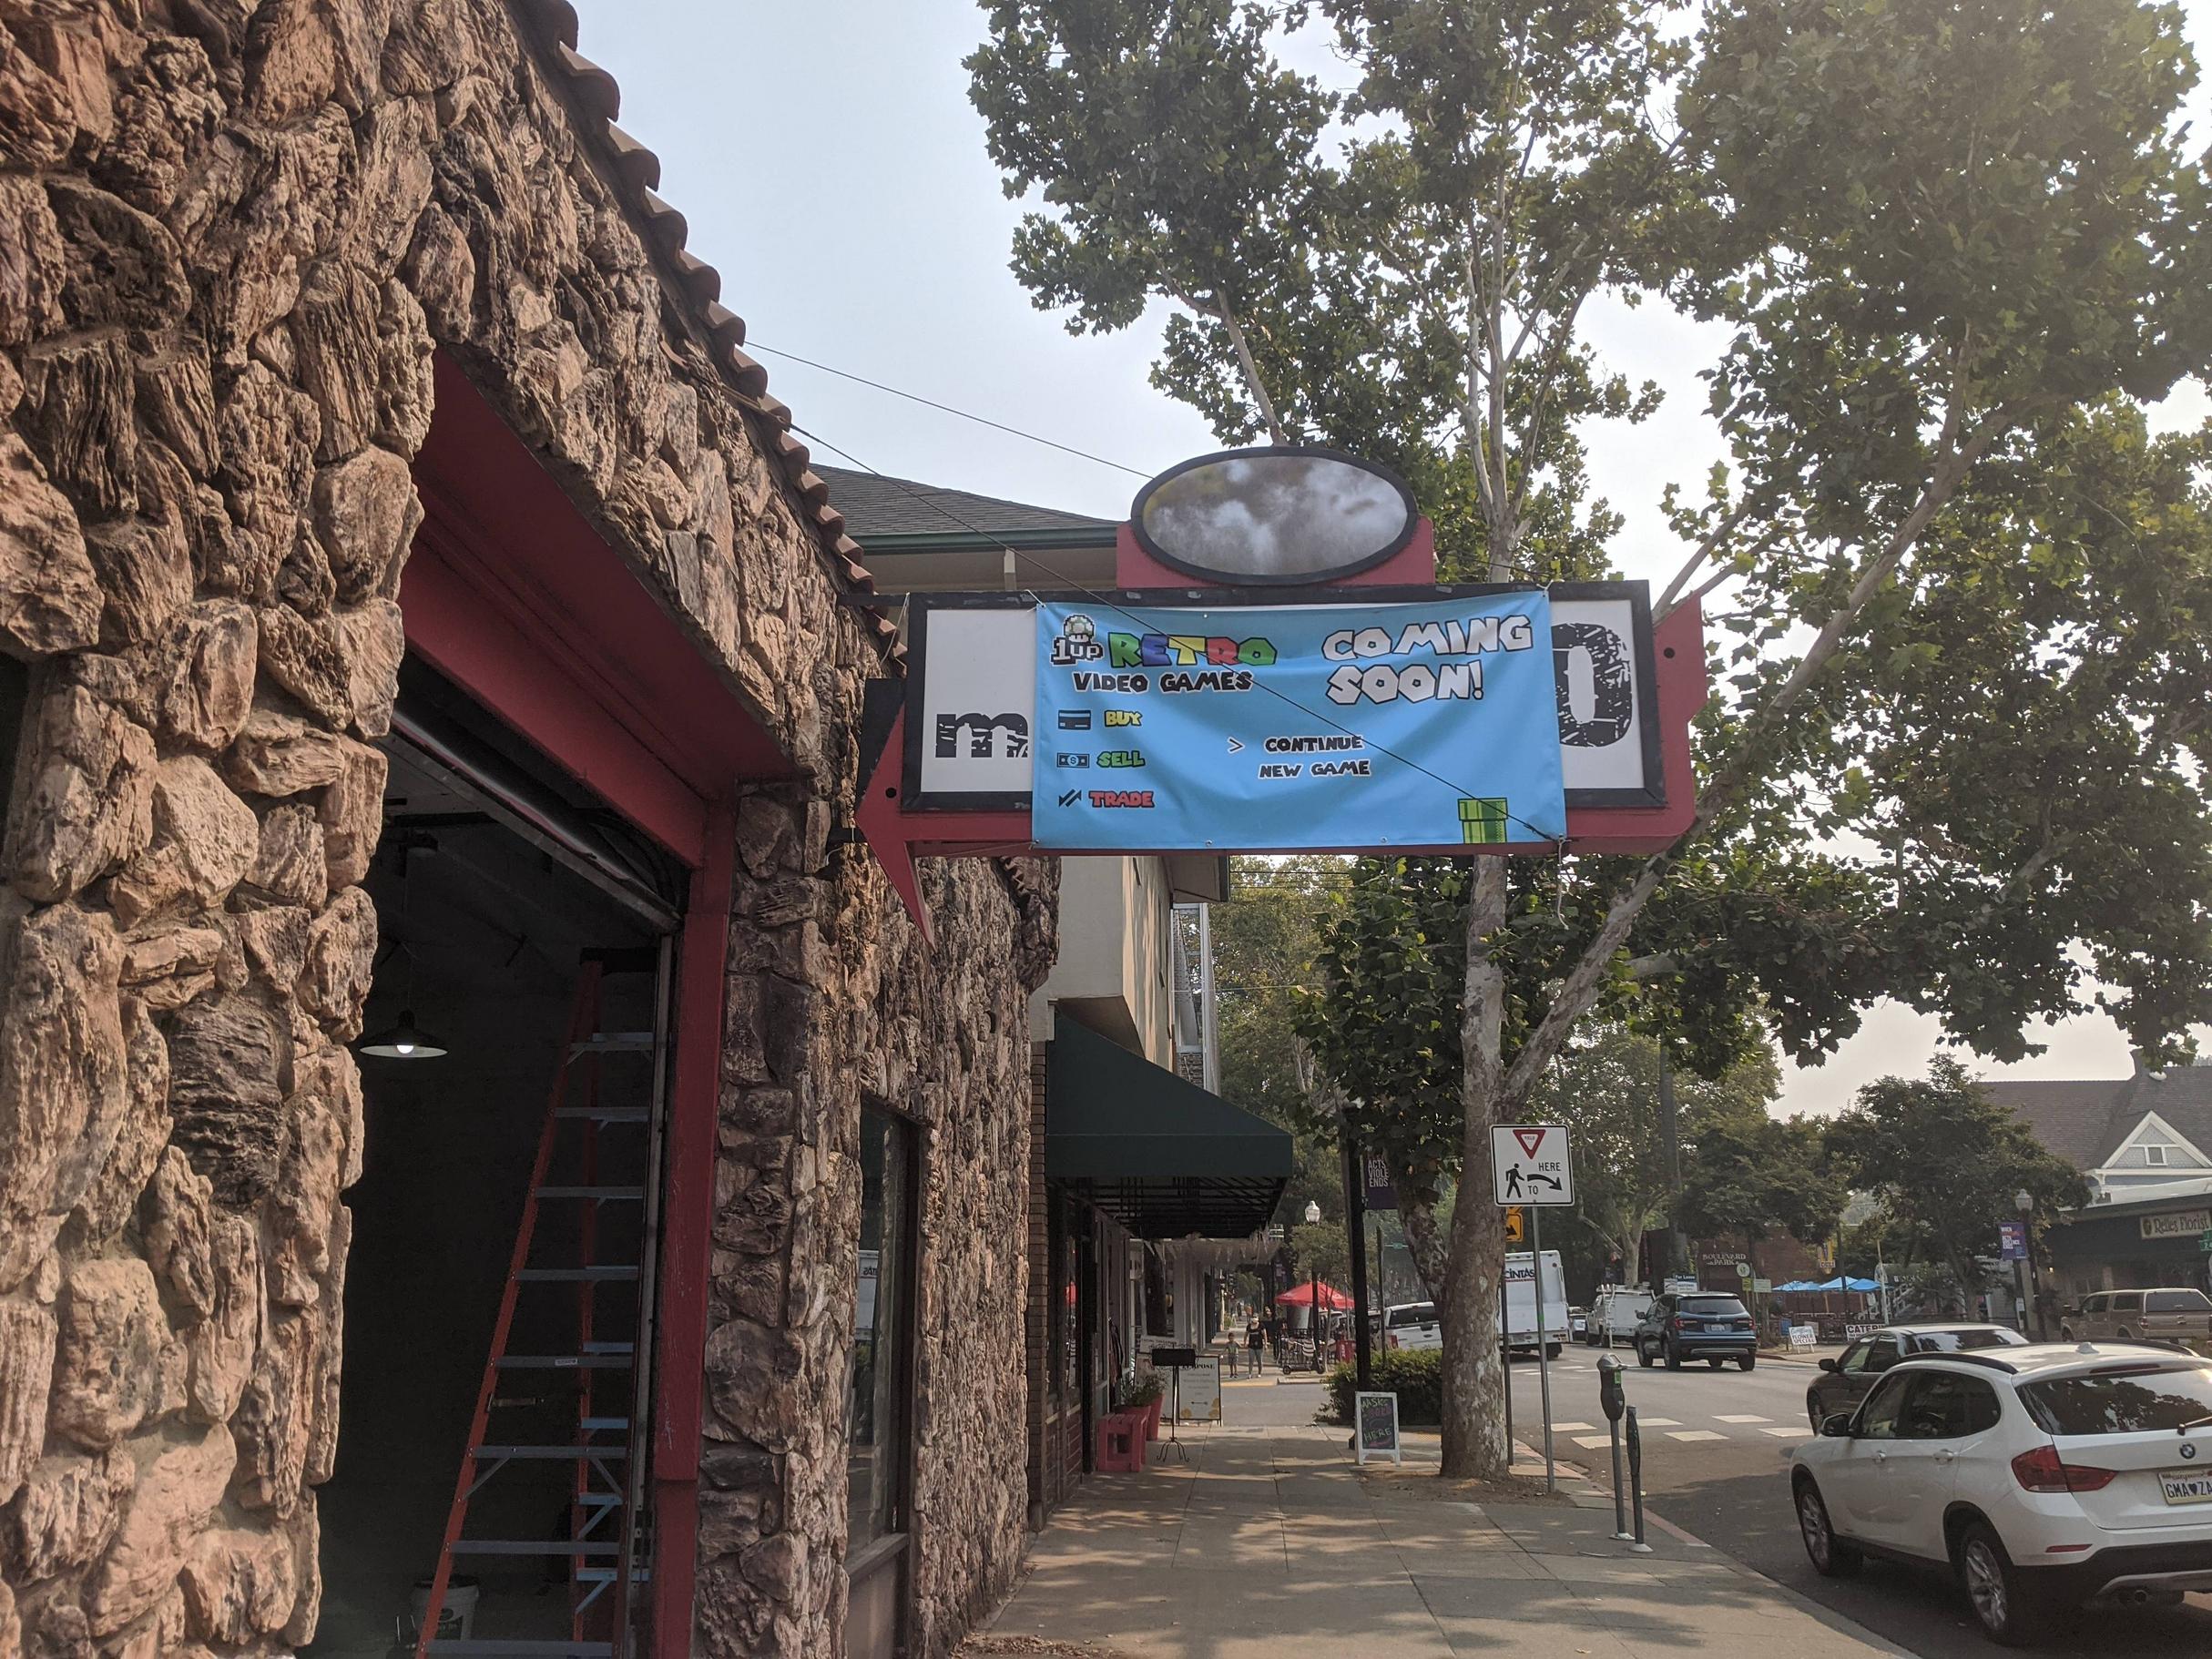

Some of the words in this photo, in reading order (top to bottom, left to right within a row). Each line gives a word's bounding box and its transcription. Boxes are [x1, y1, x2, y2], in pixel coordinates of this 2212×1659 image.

[1321, 615, 1534, 661] COMING
[1051, 637, 1103, 665] 1UP
[1107, 632, 1278, 668] RETRO
[1073, 672, 1148, 693] VIDEO
[1159, 671, 1253, 693] GAMES
[1326, 659, 1483, 705] SOON!
[1105, 710, 1142, 727] BUY
[1265, 736, 1363, 752] CONTINUE
[1096, 750, 1146, 768] SELL
[1259, 763, 1302, 779] NEW
[1310, 759, 1371, 776] GAME
[1088, 790, 1155, 808] TRADE
[1368, 1160, 1386, 1169] ACTS
[1538, 1163, 1561, 1172] HERE
[1369, 1177, 1389, 1187] ENDS
[1527, 1186, 1538, 1195] TO
[2179, 1214, 2209, 1231] Florist
[1363, 1428, 1392, 1442] HERE
